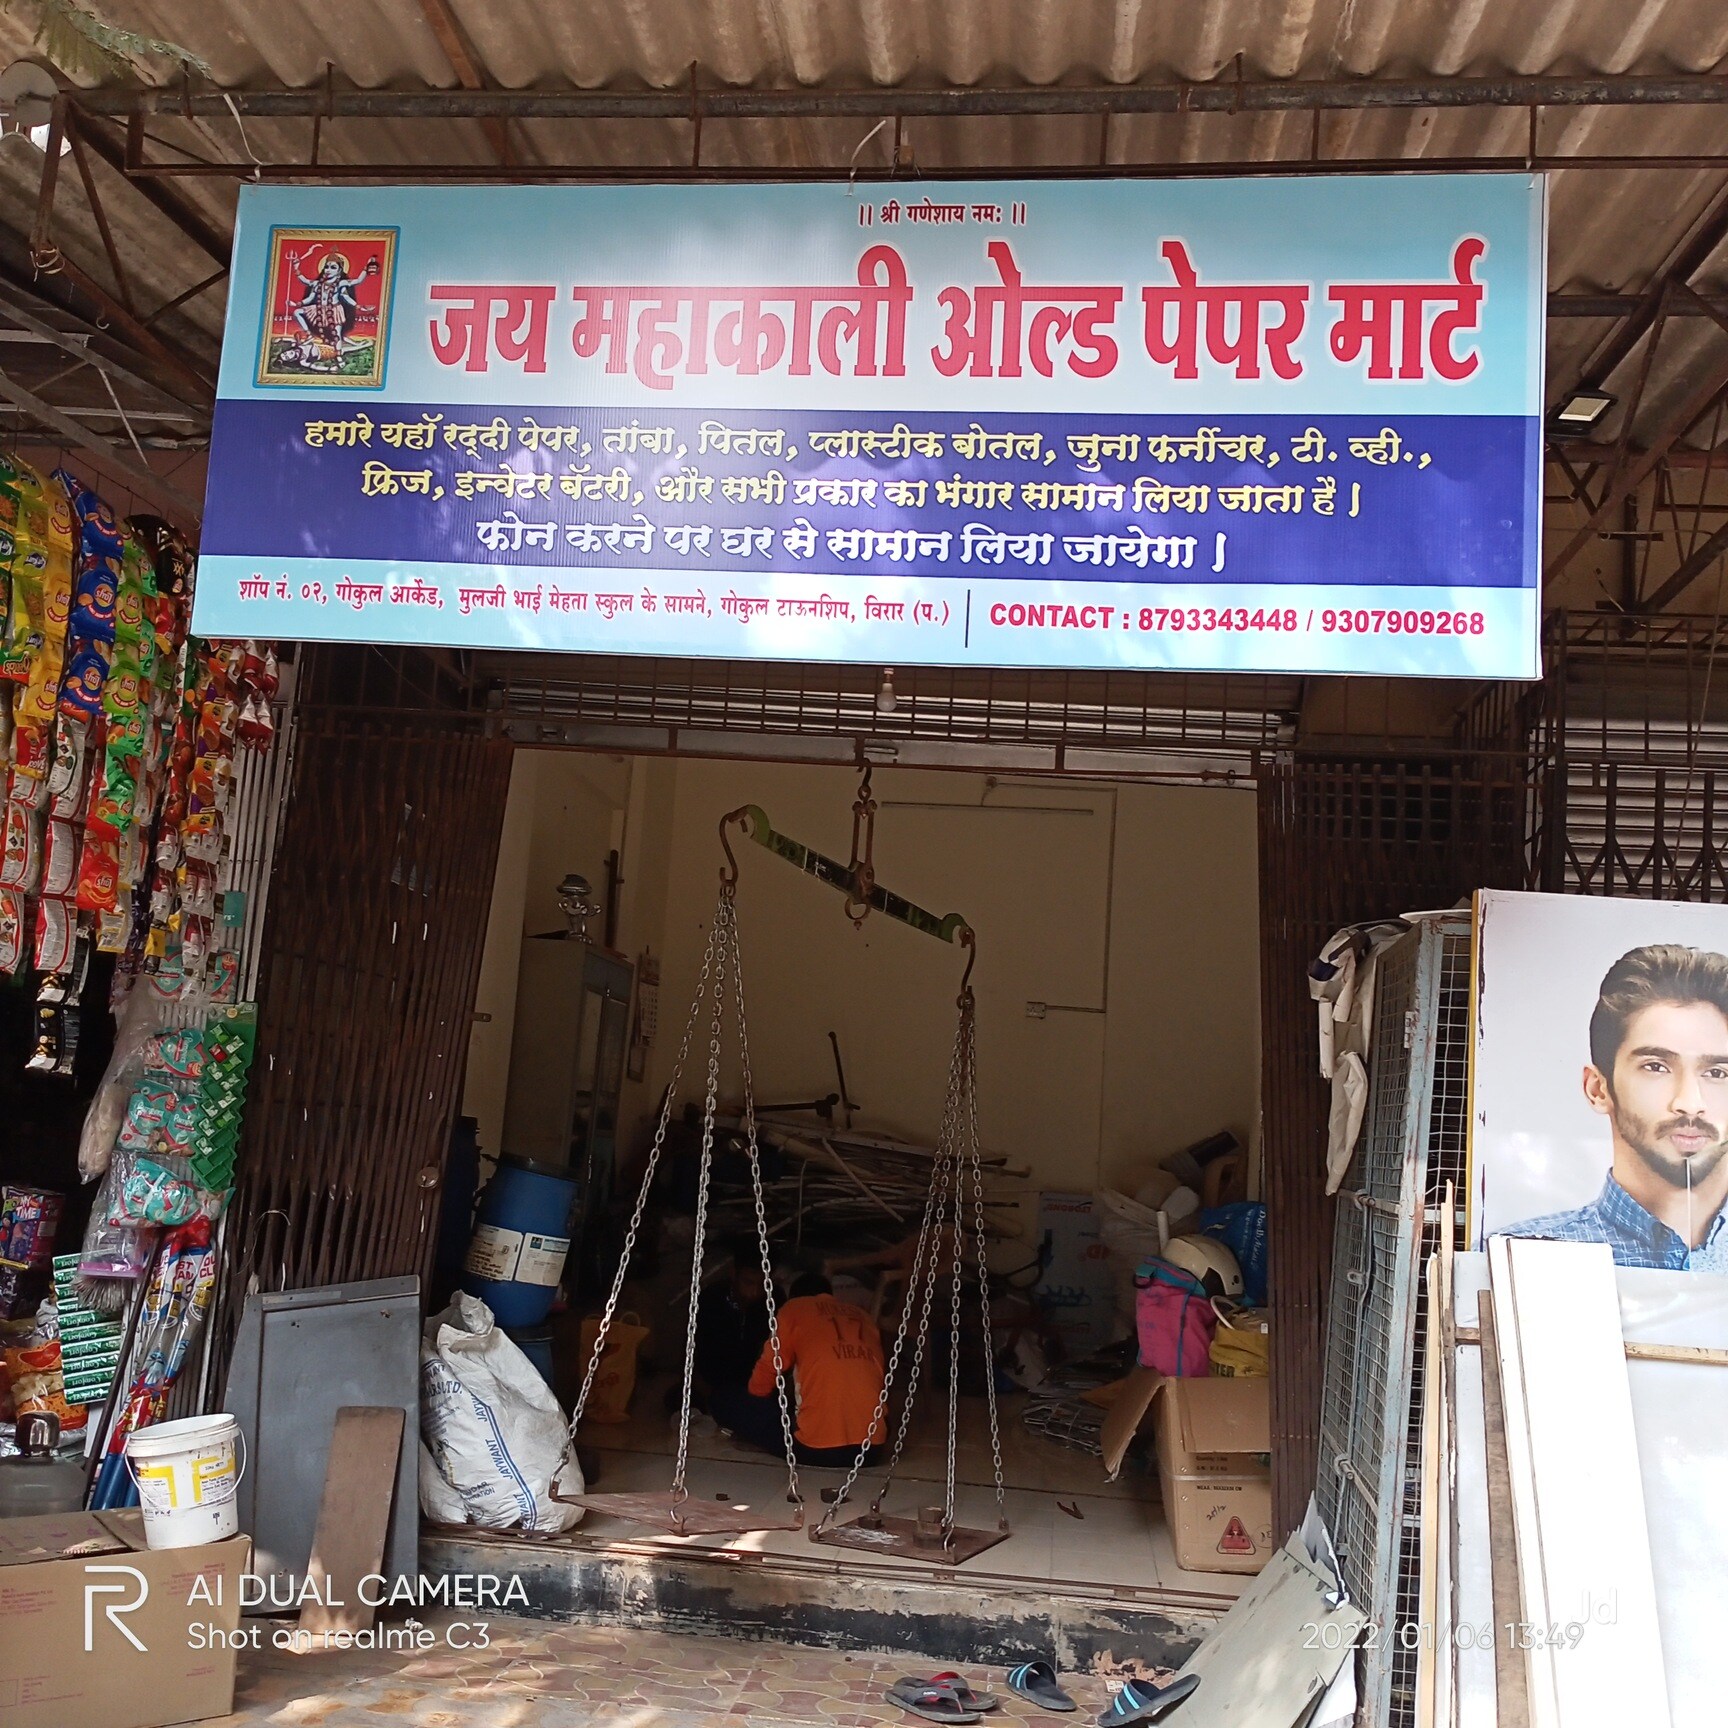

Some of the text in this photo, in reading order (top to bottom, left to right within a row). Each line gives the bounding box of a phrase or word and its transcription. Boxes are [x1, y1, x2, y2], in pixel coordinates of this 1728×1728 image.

[880, 200, 901, 223] श्री
[906, 198, 965, 224] गणेशाय
[429, 236, 1487, 390] जय महाकाली ओल्ड पेपर मार्ट
[305, 414, 375, 448] हमारे
[518, 417, 593, 457] पेपर,
[602, 419, 687, 459] तांबा,
[699, 421, 799, 461] पितल,
[808, 423, 945, 458] प्लास्टीक
[952, 423, 1056, 466] बोतल,
[1067, 434, 1141, 472] जुना
[1147, 427, 1281, 468] फर्नीचर,
[1291, 428, 1338, 462] टी.
[1348, 428, 1432, 469] व्ही.,
[361, 461, 445, 500] फ्रिज,
[455, 464, 552, 500] इन्वेटर
[559, 464, 643, 506] बॅटरी,
[655, 467, 714, 503] और
[721, 470, 787, 504] सभी
[793, 479, 878, 508] प्रकार
[884, 480, 928, 507] का
[935, 474, 1015, 509] भंगार
[1022, 483, 1126, 512] सामान
[1133, 478, 1210, 513] लिया
[1217, 484, 1304, 513] जाता
[1311, 476, 1336, 515] है
[476, 511, 558, 550] फोन
[565, 514, 656, 554] करने
[664, 524, 713, 557] पर
[721, 526, 774, 558] घर
[782, 518, 819, 558] से
[826, 529, 952, 562] सामान
[960, 523, 1054, 564] लिया
[1062, 526, 1198, 567] जायेगा
[95, 588, 113, 601] Lay's
[239, 575, 269, 600] शॉप
[275, 574, 293, 601] नं.
[302, 582, 327, 604] ०२,
[336, 577, 383, 609] गोकुल
[458, 584, 506, 613] मुलजी
[513, 584, 542, 613] भाई
[549, 585, 588, 612] मेहता
[595, 593, 634, 619] स्कुल
[641, 587, 656, 612] के
[664, 588, 712, 618] सामने,
[720, 590, 769, 623] गोकुल
[776, 594, 855, 623] टाऊनशिप,
[864, 595, 904, 621] विरार
[913, 600, 950, 626] (प.)
[990, 603, 1485, 635] CONTACT : 8793343448 / 9307909268
[84, 672, 101, 685] Lay's
[97, 877, 113, 889] Lay's
[68, 1331, 97, 1343] Comfort
[69, 1347, 99, 1357] Comfort
[72, 1376, 101, 1387] Comfort
[485, 1438, 514, 1480] JAYWANT
